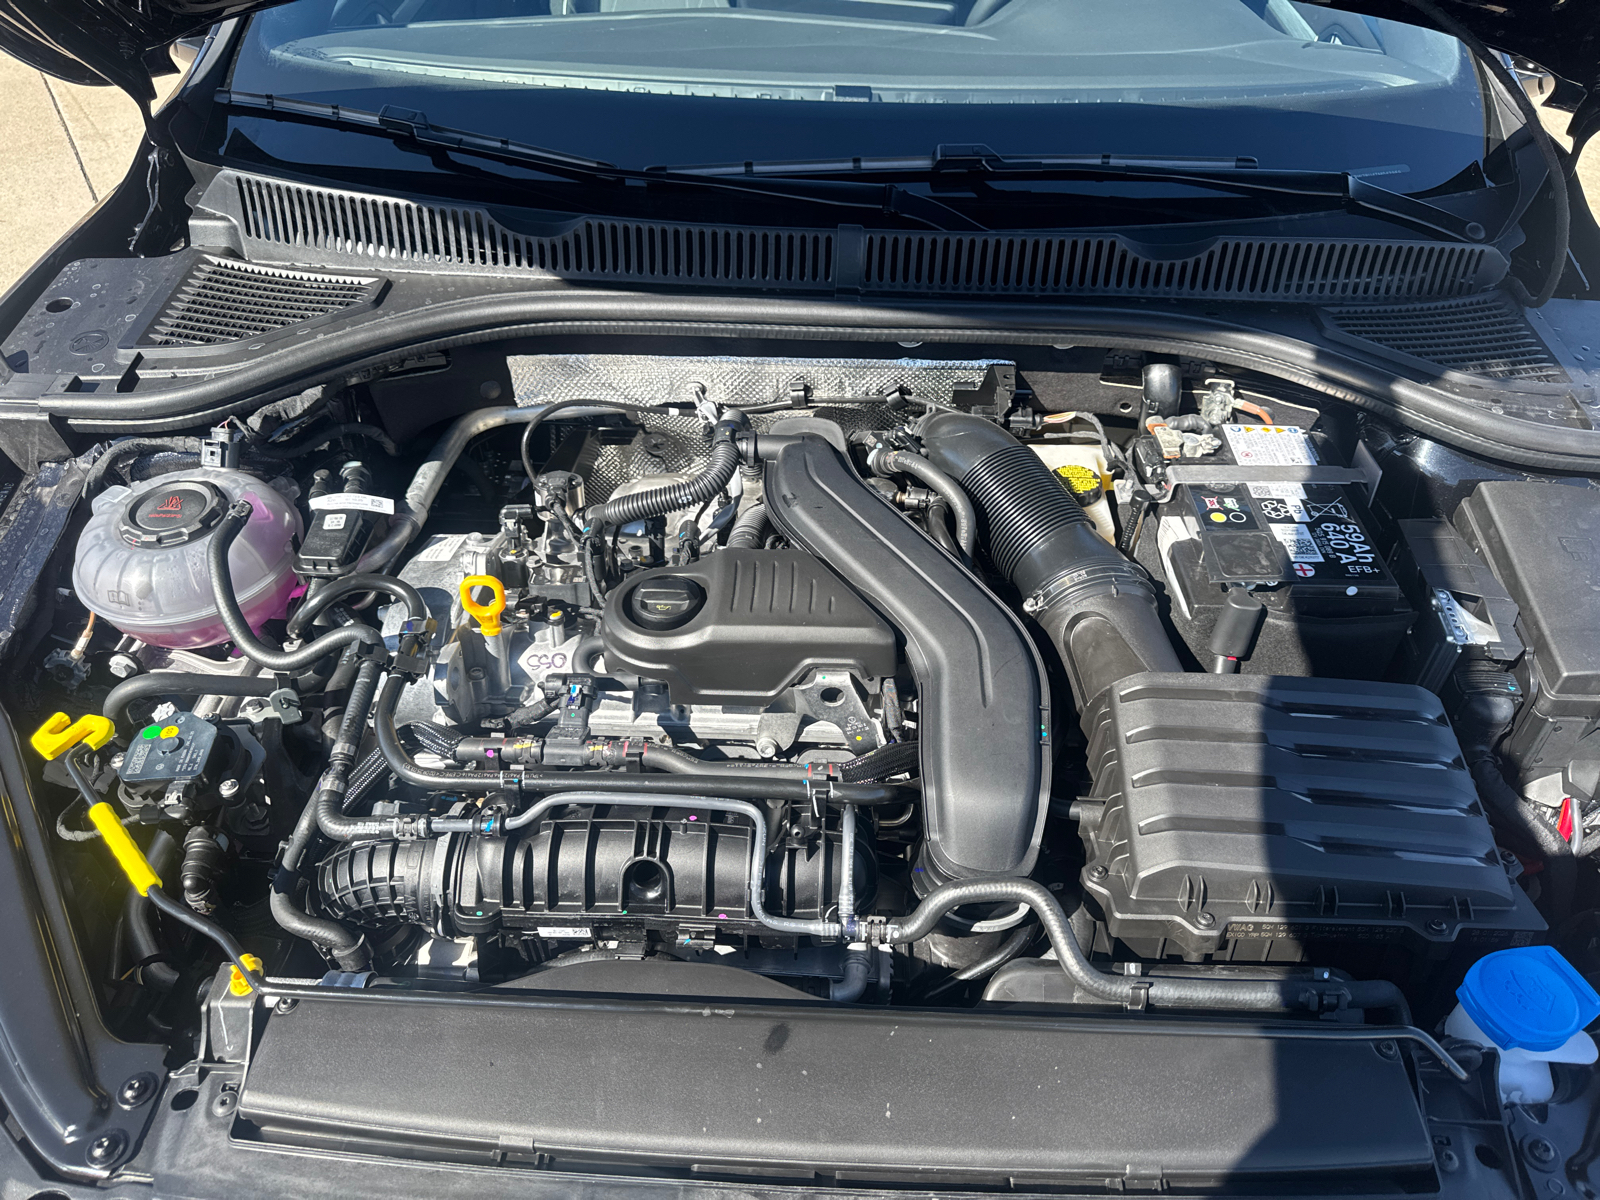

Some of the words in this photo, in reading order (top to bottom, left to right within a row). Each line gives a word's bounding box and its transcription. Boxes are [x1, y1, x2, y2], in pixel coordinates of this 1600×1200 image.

[1293, 504, 1303, 514] Pb
[1321, 522, 1350, 549] 640
[1341, 524, 1375, 563] 59Ah
[1335, 552, 1358, 564] A
[1347, 565, 1380, 574] EFB+
